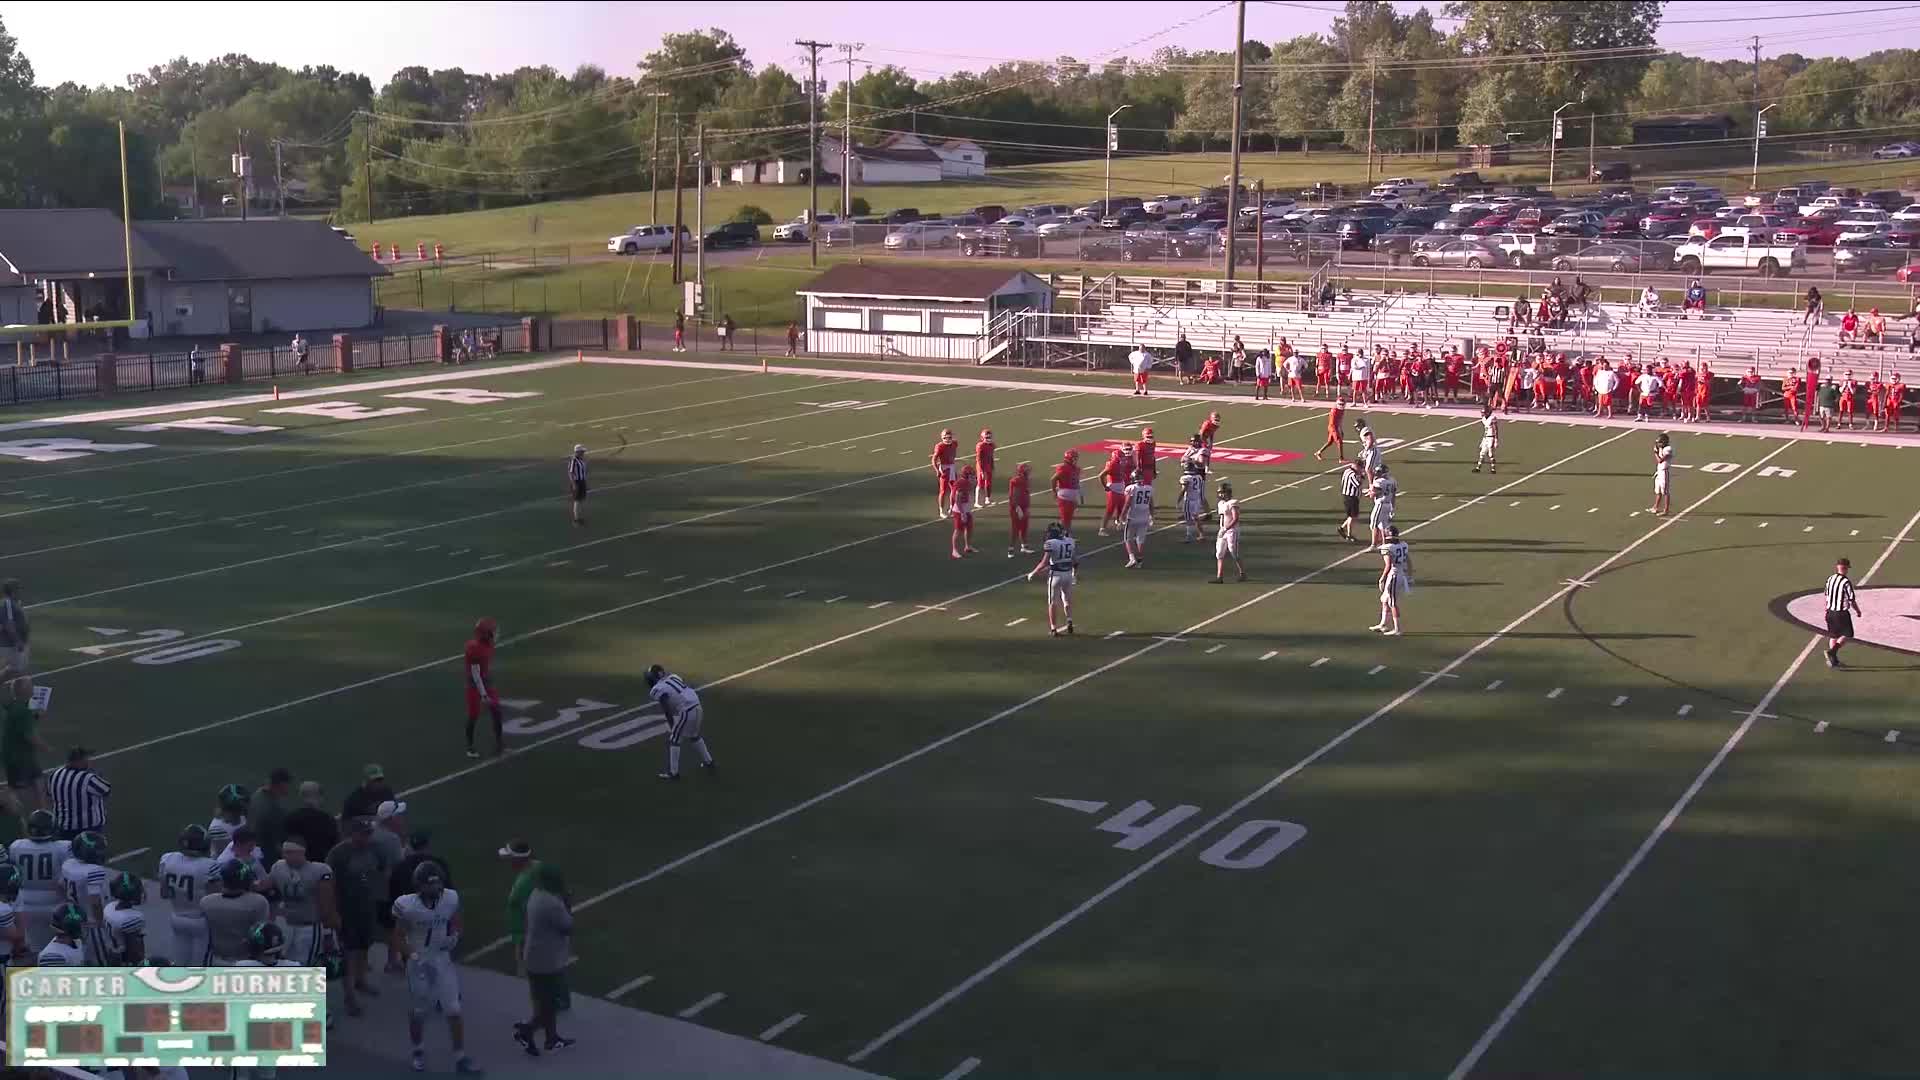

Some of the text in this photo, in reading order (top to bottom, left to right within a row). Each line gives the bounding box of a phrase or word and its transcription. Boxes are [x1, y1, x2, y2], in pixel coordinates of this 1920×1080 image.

[1136, 490, 1151, 505] 65
[1059, 543, 1072, 559] 15
[1395, 547, 1408, 564] 25
[68, 629, 243, 665] 20
[501, 699, 668, 750] 30
[1095, 800, 1307, 869] 40
